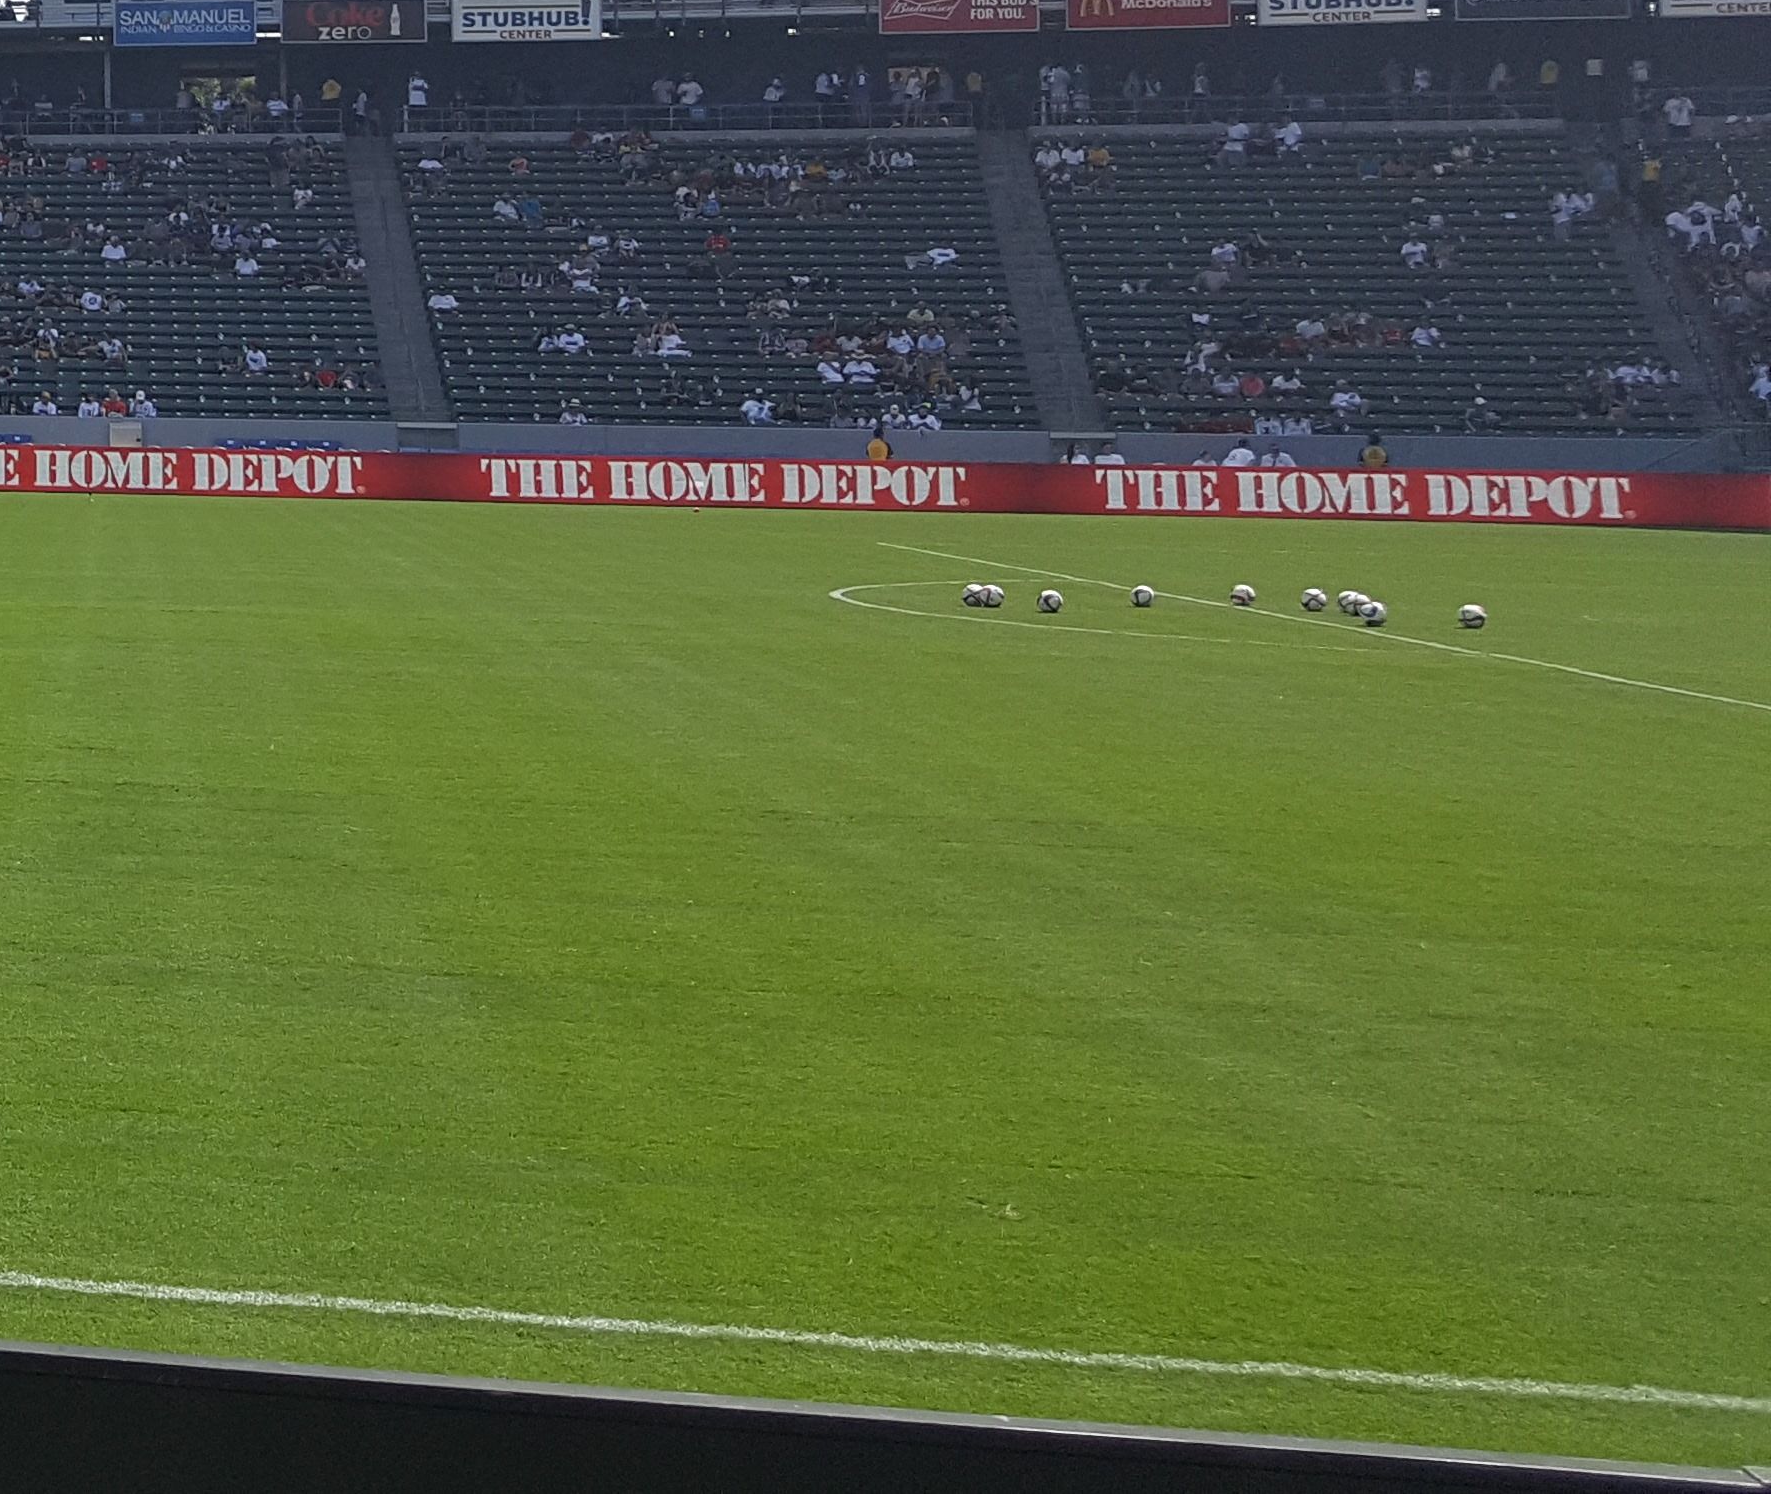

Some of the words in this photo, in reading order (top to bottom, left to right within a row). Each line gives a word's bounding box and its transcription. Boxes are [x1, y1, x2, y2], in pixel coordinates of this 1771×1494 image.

[119, 10, 159, 26] SAN
[170, 9, 251, 24] MANUEL
[970, 8, 994, 20] FOR
[997, 8, 1026, 20] YOU.
[1313, 11, 1371, 23] CENTER
[318, 26, 372, 40] zero
[499, 29, 553, 40] CENTER
[33, 448, 174, 490] HOME
[194, 451, 362, 495] DEPOT
[482, 458, 595, 499] THE
[608, 460, 766, 501] HOME
[779, 463, 967, 506] DEPOT
[1095, 468, 1220, 512] THE
[1237, 471, 1410, 515] HOME
[1427, 474, 1630, 520] DEPOT
